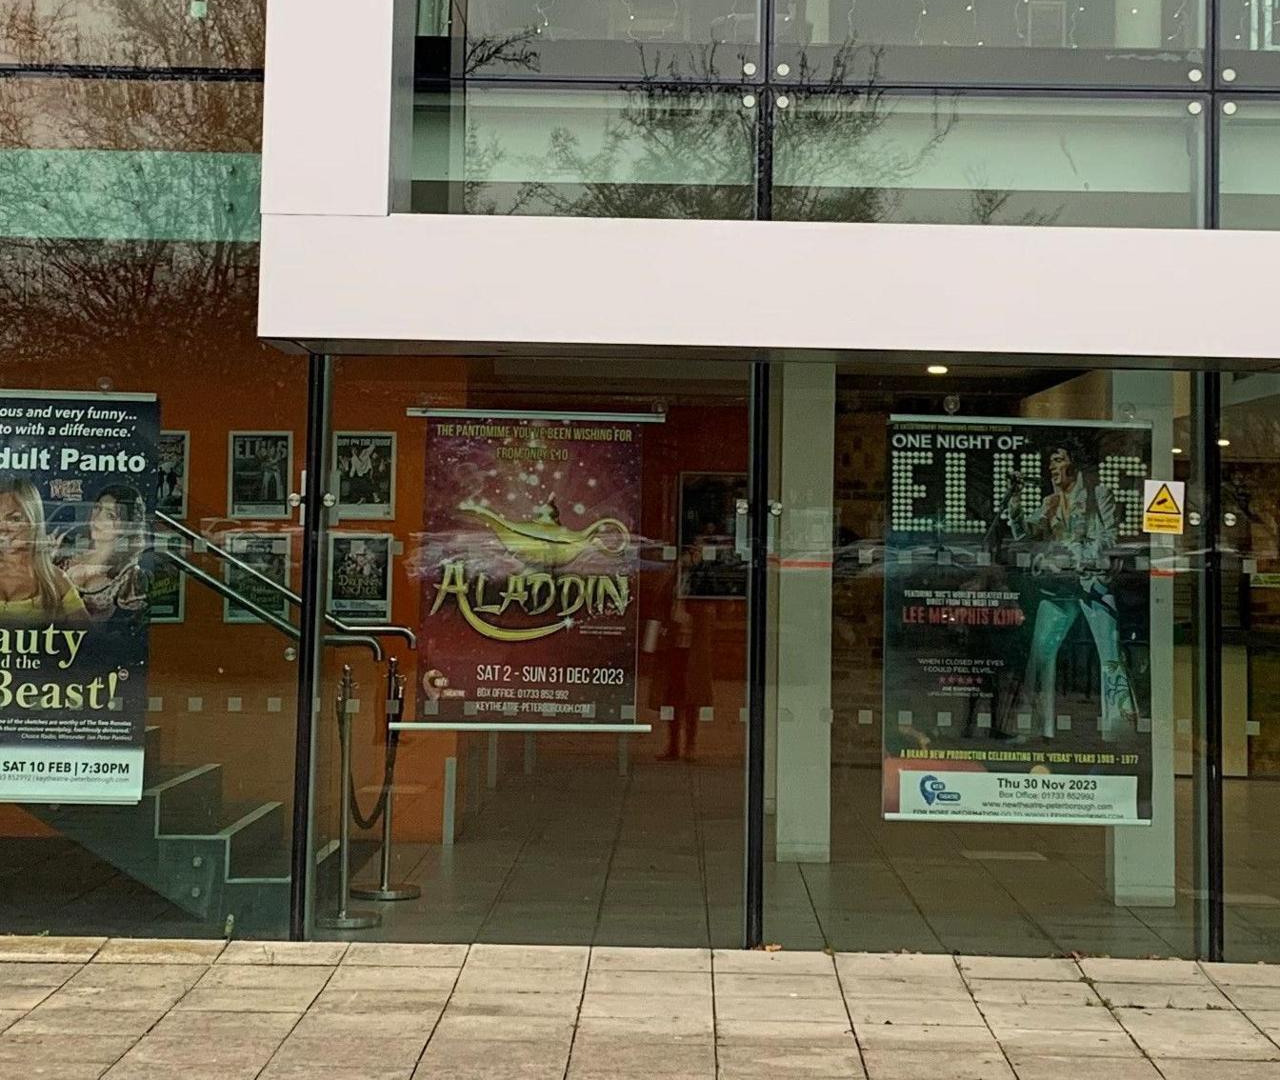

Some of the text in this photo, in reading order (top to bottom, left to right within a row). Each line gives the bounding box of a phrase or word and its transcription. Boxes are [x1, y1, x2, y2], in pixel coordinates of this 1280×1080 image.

[25, 406, 52, 419] and
[54, 408, 85, 422] very
[85, 406, 138, 423] funny...
[14, 423, 46, 437] with
[47, 426, 56, 437] a
[436, 424, 633, 441] THE PANTOMIME BEEN WISHING FOR
[891, 433, 1025, 451] ONE NIGHT OF
[60, 448, 147, 473] Panto
[429, 558, 633, 636] ALADDIN
[902, 606, 990, 625] LEE MEMPHIS
[15, 655, 41, 670] the
[945, 658, 973, 666] CLOSED
[476, 664, 624, 685] SAT 2 SUN 31 DEC 2023
[476, 687, 492, 698] BOX
[517, 688, 540, 699] 01733
[946, 750, 987, 761] PRODUCTION
[987, 751, 1031, 763] CELEBRATING
[1031, 752, 1045, 763] THE
[1073, 753, 1096, 764] YEARS
[2, 761, 130, 775] SAT 10 FEB 7:30PM
[996, 777, 1098, 791] Thu 30 Nov 2023
[999, 791, 1014, 800] Box
